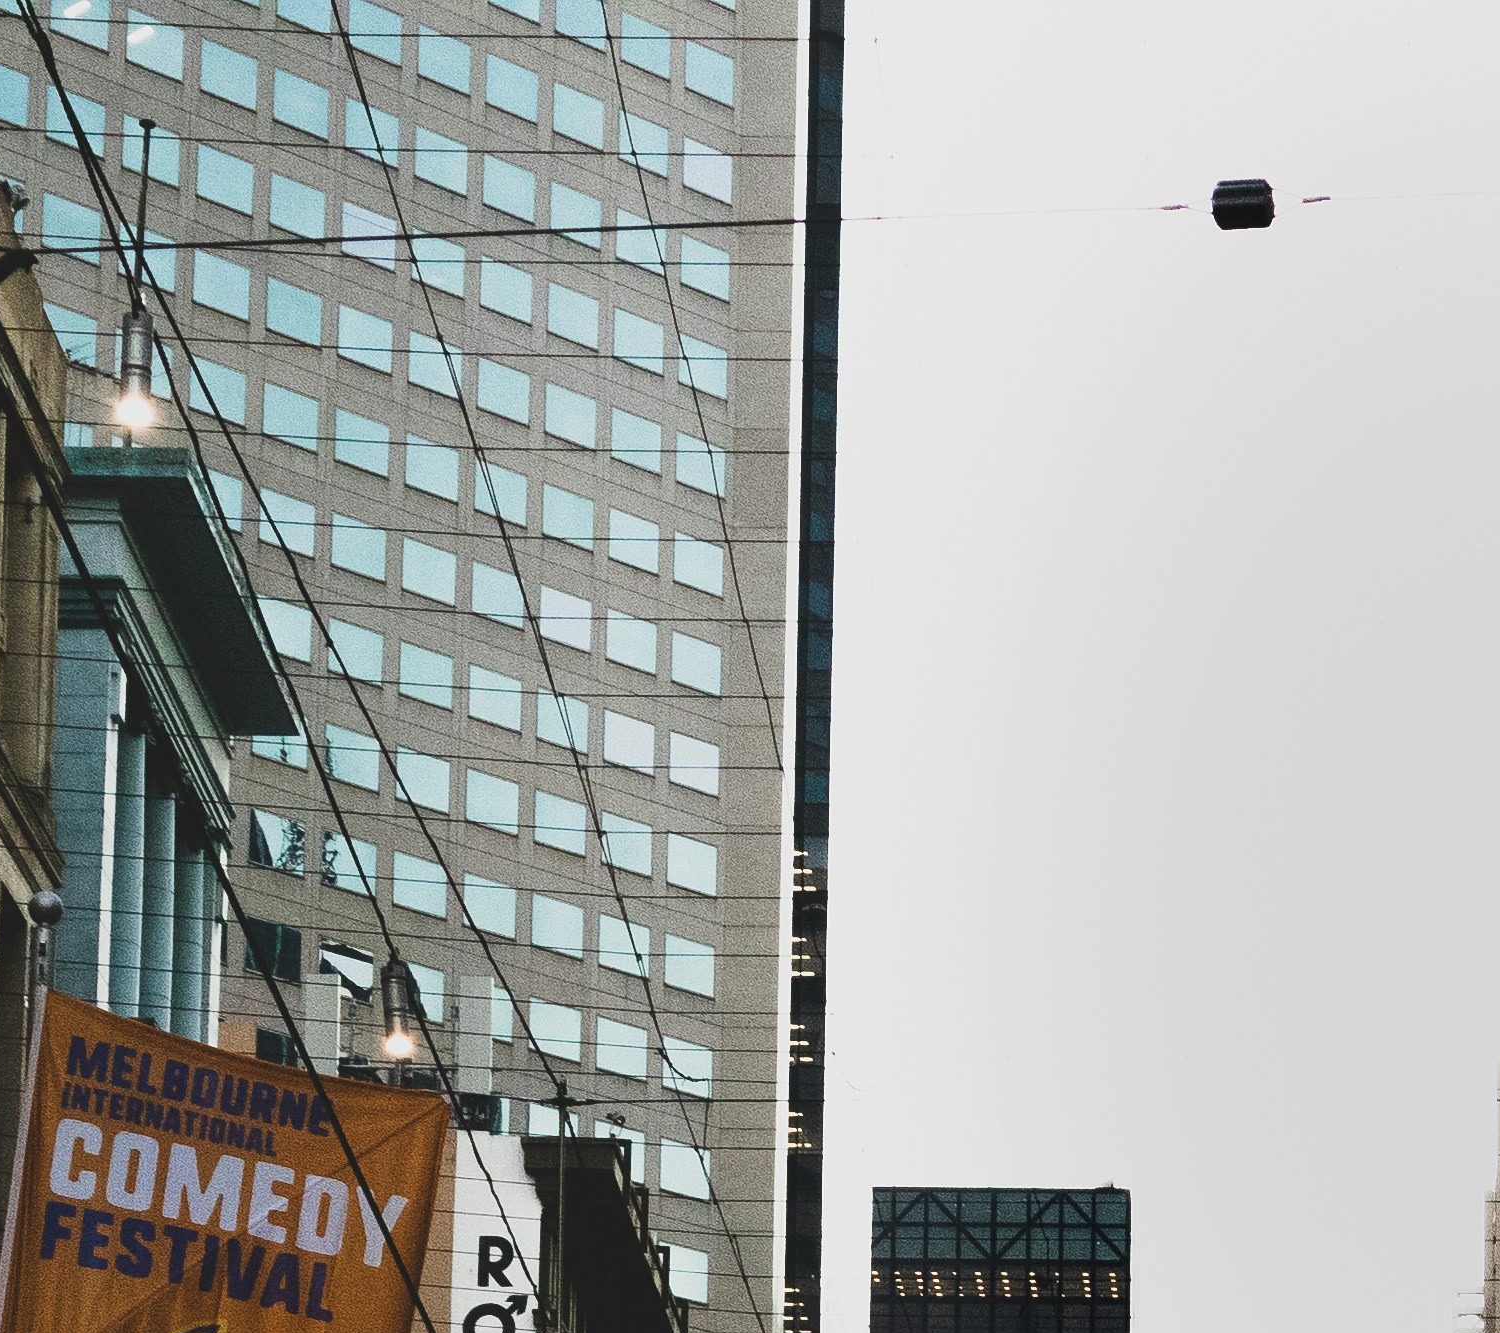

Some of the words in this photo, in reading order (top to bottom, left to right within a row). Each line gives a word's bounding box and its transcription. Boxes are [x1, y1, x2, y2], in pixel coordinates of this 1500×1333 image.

[62, 1082, 277, 1157] INTERNATIONAL
[66, 1035, 334, 1137] MELBOURNE
[48, 1117, 410, 1269] COMEDY
[39, 1200, 332, 1322] FESTIVAL
